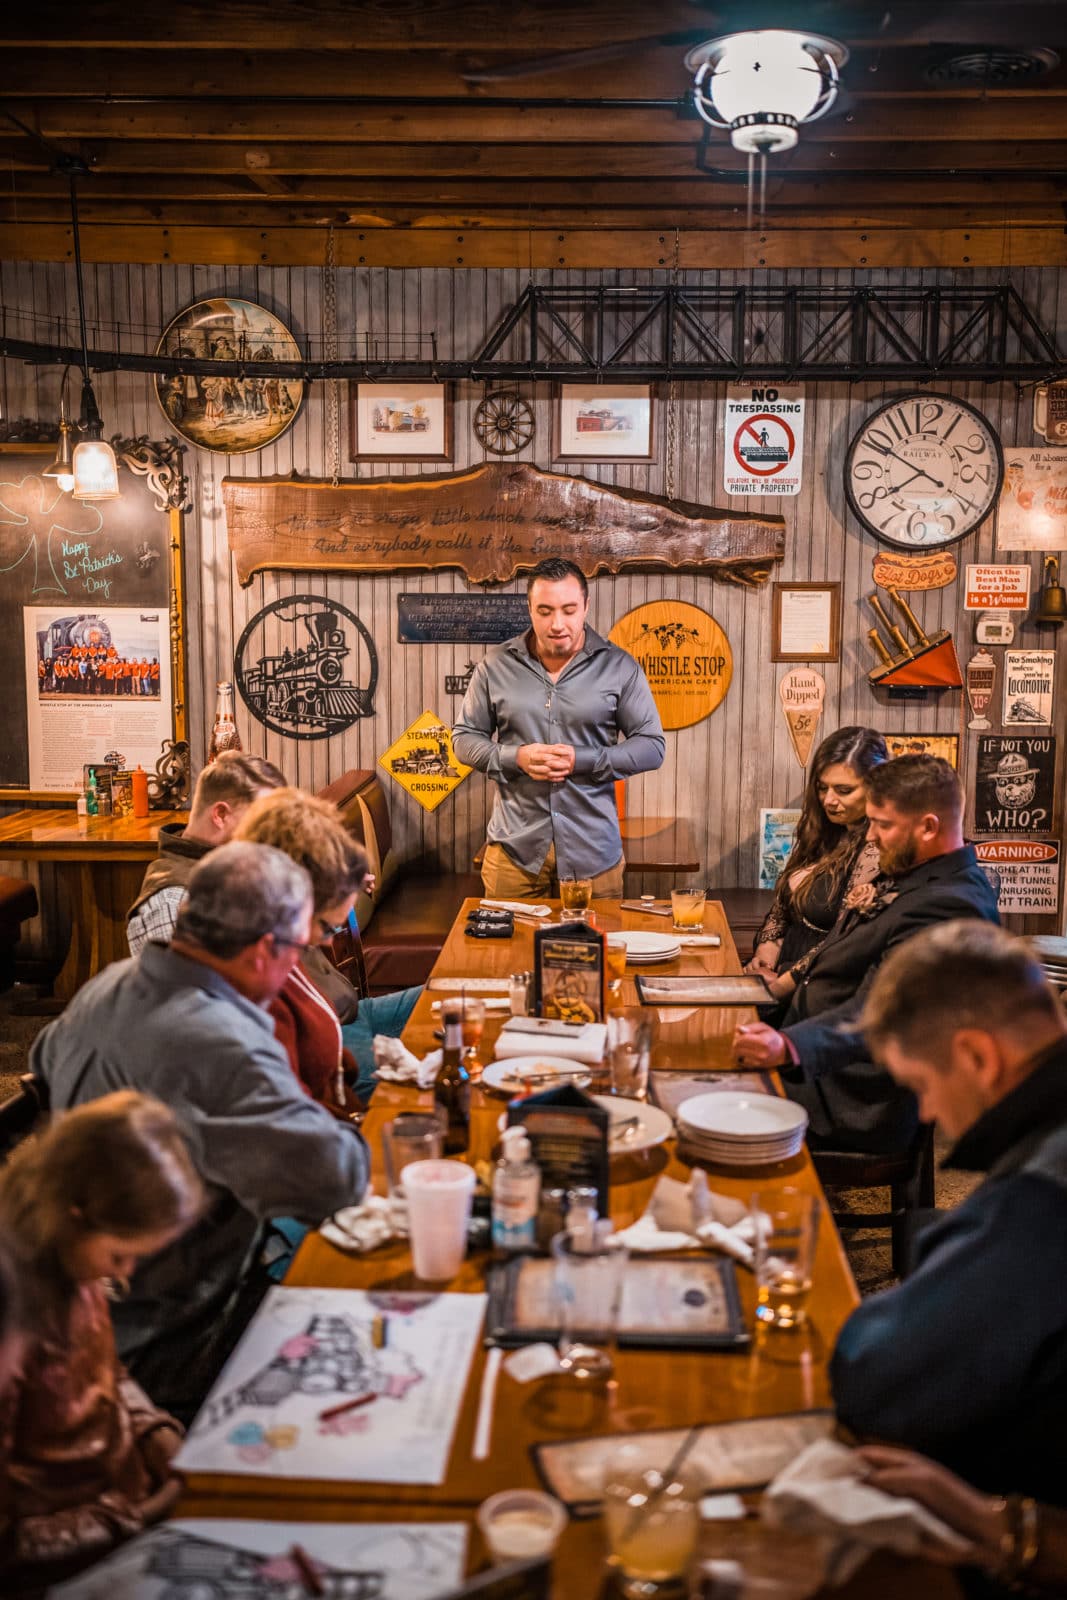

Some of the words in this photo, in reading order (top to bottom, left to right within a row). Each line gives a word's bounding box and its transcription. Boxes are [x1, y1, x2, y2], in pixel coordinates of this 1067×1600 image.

[752, 389, 779, 402] NO
[729, 405, 801, 413] TRESPASSING
[883, 407, 913, 441] 11
[911, 403, 944, 436] 12
[942, 411, 963, 440] 1
[861, 429, 894, 457] 10
[952, 433, 986, 463] 2
[903, 451, 944, 459] RAILWAY
[1030, 454, 1041, 462] All
[853, 460, 884, 480] 9
[959, 464, 991, 486] 3
[730, 484, 757, 492] PRIVATE
[760, 484, 794, 493] PROPERTY
[859, 486, 888, 509] 8
[951, 492, 980, 515] 4
[879, 501, 906, 529] 7
[933, 504, 956, 536] 5
[906, 511, 927, 541] 6
[61, 540, 91, 557] Happy
[312, 537, 349, 555] And
[435, 531, 473, 550] calls
[477, 534, 494, 550] it
[495, 534, 523, 553] the
[875, 565, 905, 584] Hot
[904, 569, 944, 585] Dogs
[82, 577, 112, 599] Day
[970, 593, 979, 603] is
[988, 593, 1024, 606] Woman
[637, 653, 691, 677] WHISTLE
[694, 656, 726, 677] STOP
[1008, 655, 1020, 664] No
[1021, 655, 1053, 666] Smoking
[790, 676, 817, 689] Hand
[1008, 676, 1051, 696] LOCOMOTIVE
[786, 688, 821, 704] Dipped
[983, 740, 997, 752] IF
[1001, 740, 1023, 752] NOT
[1026, 739, 1050, 754] YOU
[410, 783, 449, 791] CROSSING
[986, 808, 1047, 829] WHO?
[975, 846, 1049, 858] WARNING!
[1019, 866, 1030, 874] AT
[1033, 866, 1051, 874] THE
[1021, 877, 1057, 885] TUNNEL
[1018, 897, 1057, 907] TRAIN!
